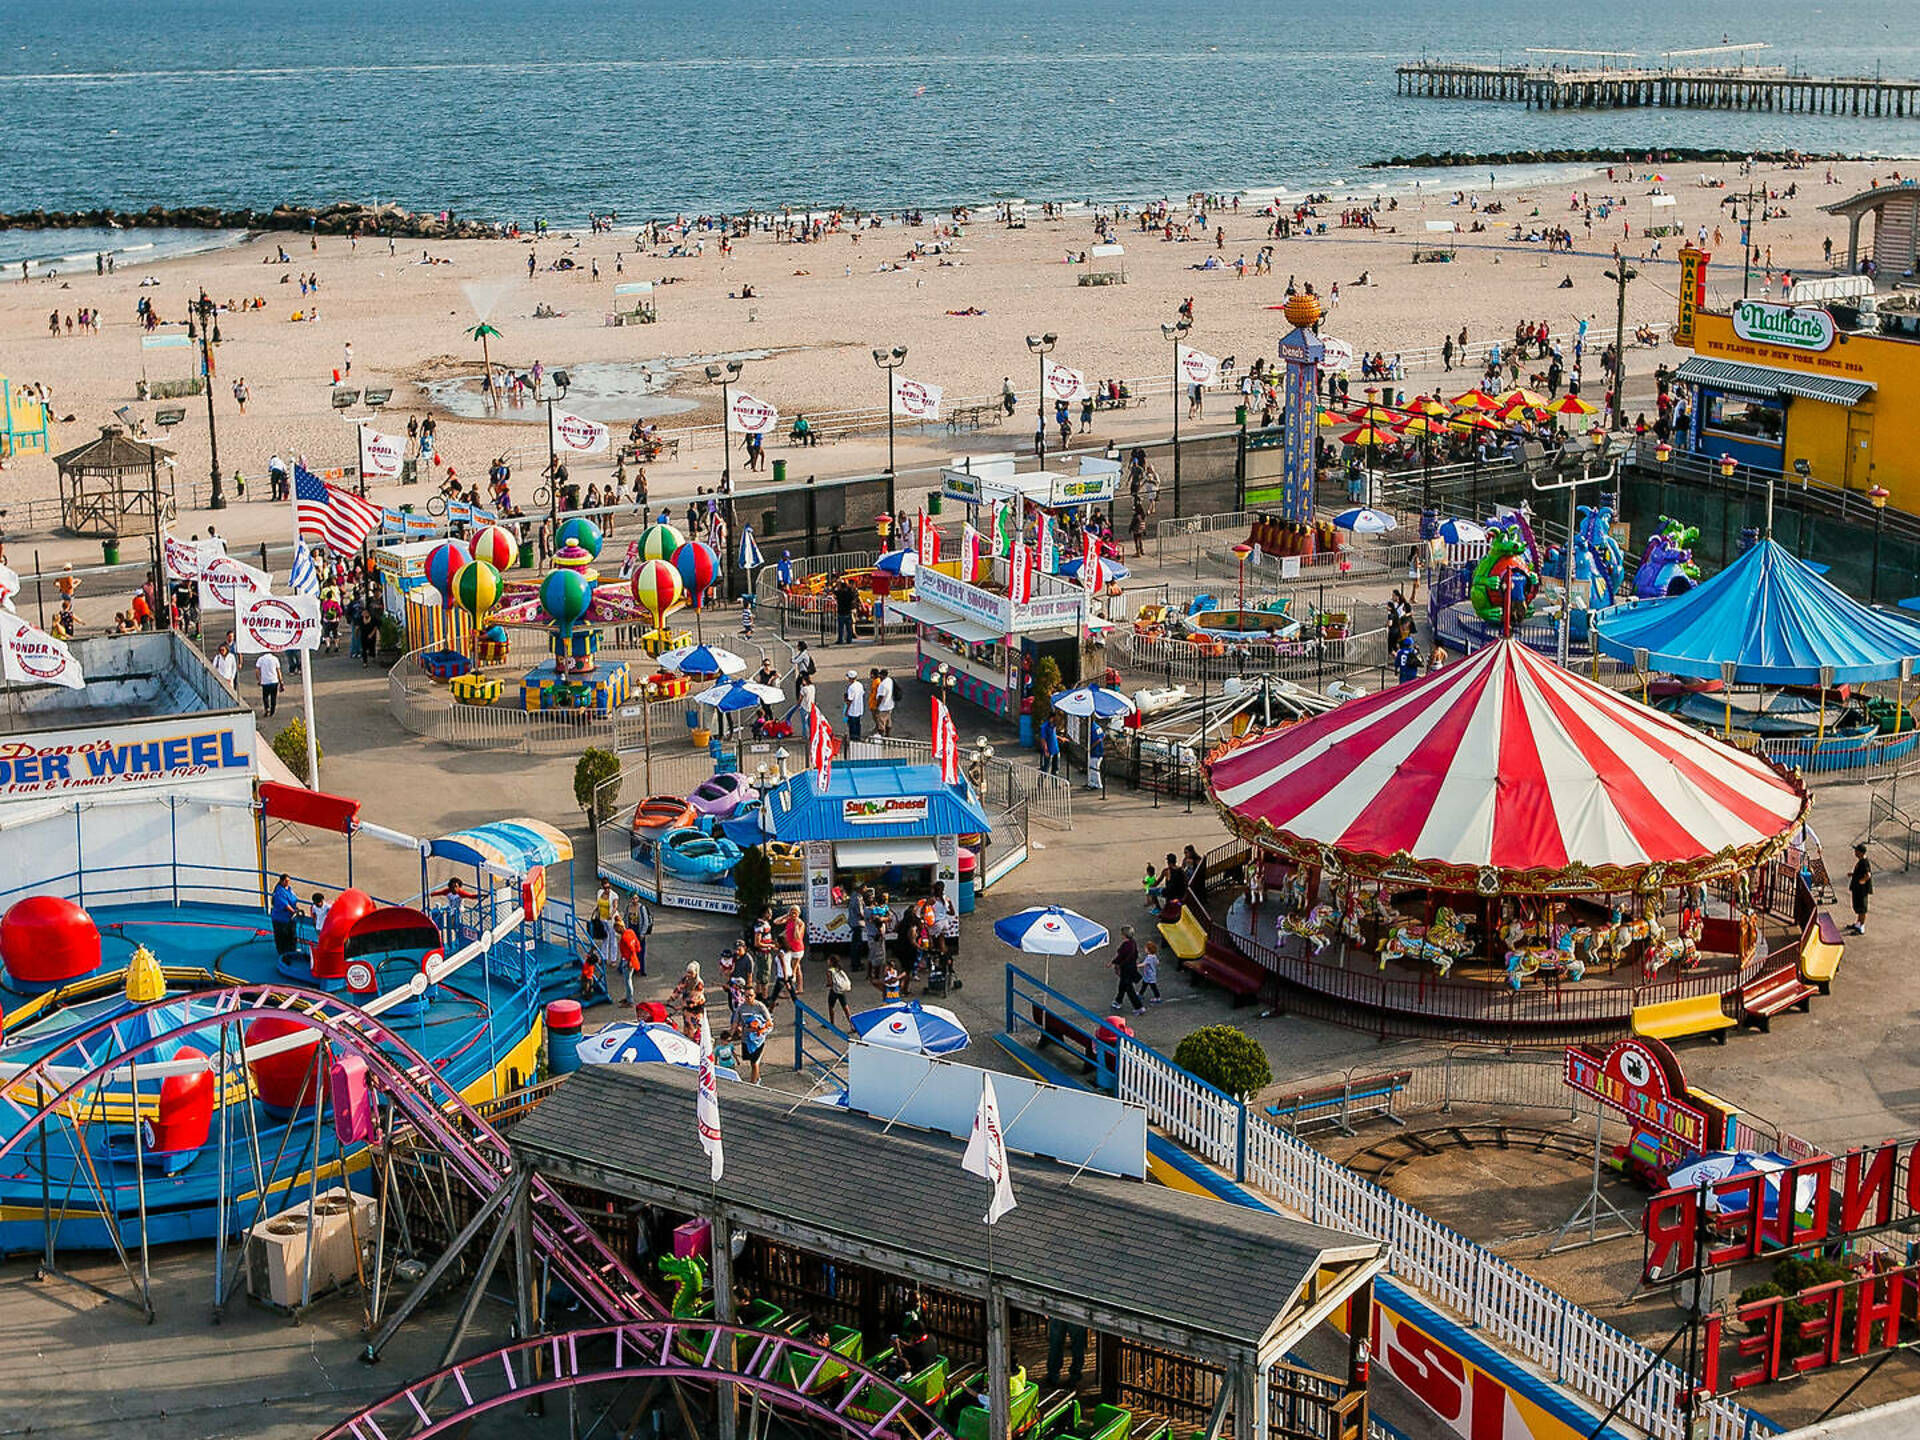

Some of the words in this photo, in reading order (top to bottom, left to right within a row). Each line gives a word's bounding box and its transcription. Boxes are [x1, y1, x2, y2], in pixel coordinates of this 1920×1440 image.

[1682, 257, 1695, 334] NATHANS
[1741, 303, 1825, 338] Nathan's
[1708, 341, 1724, 350] THE
[1726, 343, 1756, 355] FLAVOR
[1758, 348, 1769, 357] OF
[1771, 351, 1790, 360] NEW
[1792, 353, 1814, 365] YORK
[242, 616, 281, 629] WONDER
[285, 617, 315, 629] WHEEL
[0, 739, 112, 760] Deno's
[83, 729, 249, 777] WHEEL
[8, 782, 40, 794] FUN
[44, 780, 57, 790] &
[62, 774, 116, 789] FAMILY
[171, 765, 208, 777] 1920
[845, 801, 866, 815] Say
[885, 799, 927, 810] Cheese!
[678, 897, 702, 907] WILLIE
[705, 900, 718, 909] THE
[1573, 1061, 1625, 1103] TRAIN
[1628, 1087, 1696, 1140] STATION
